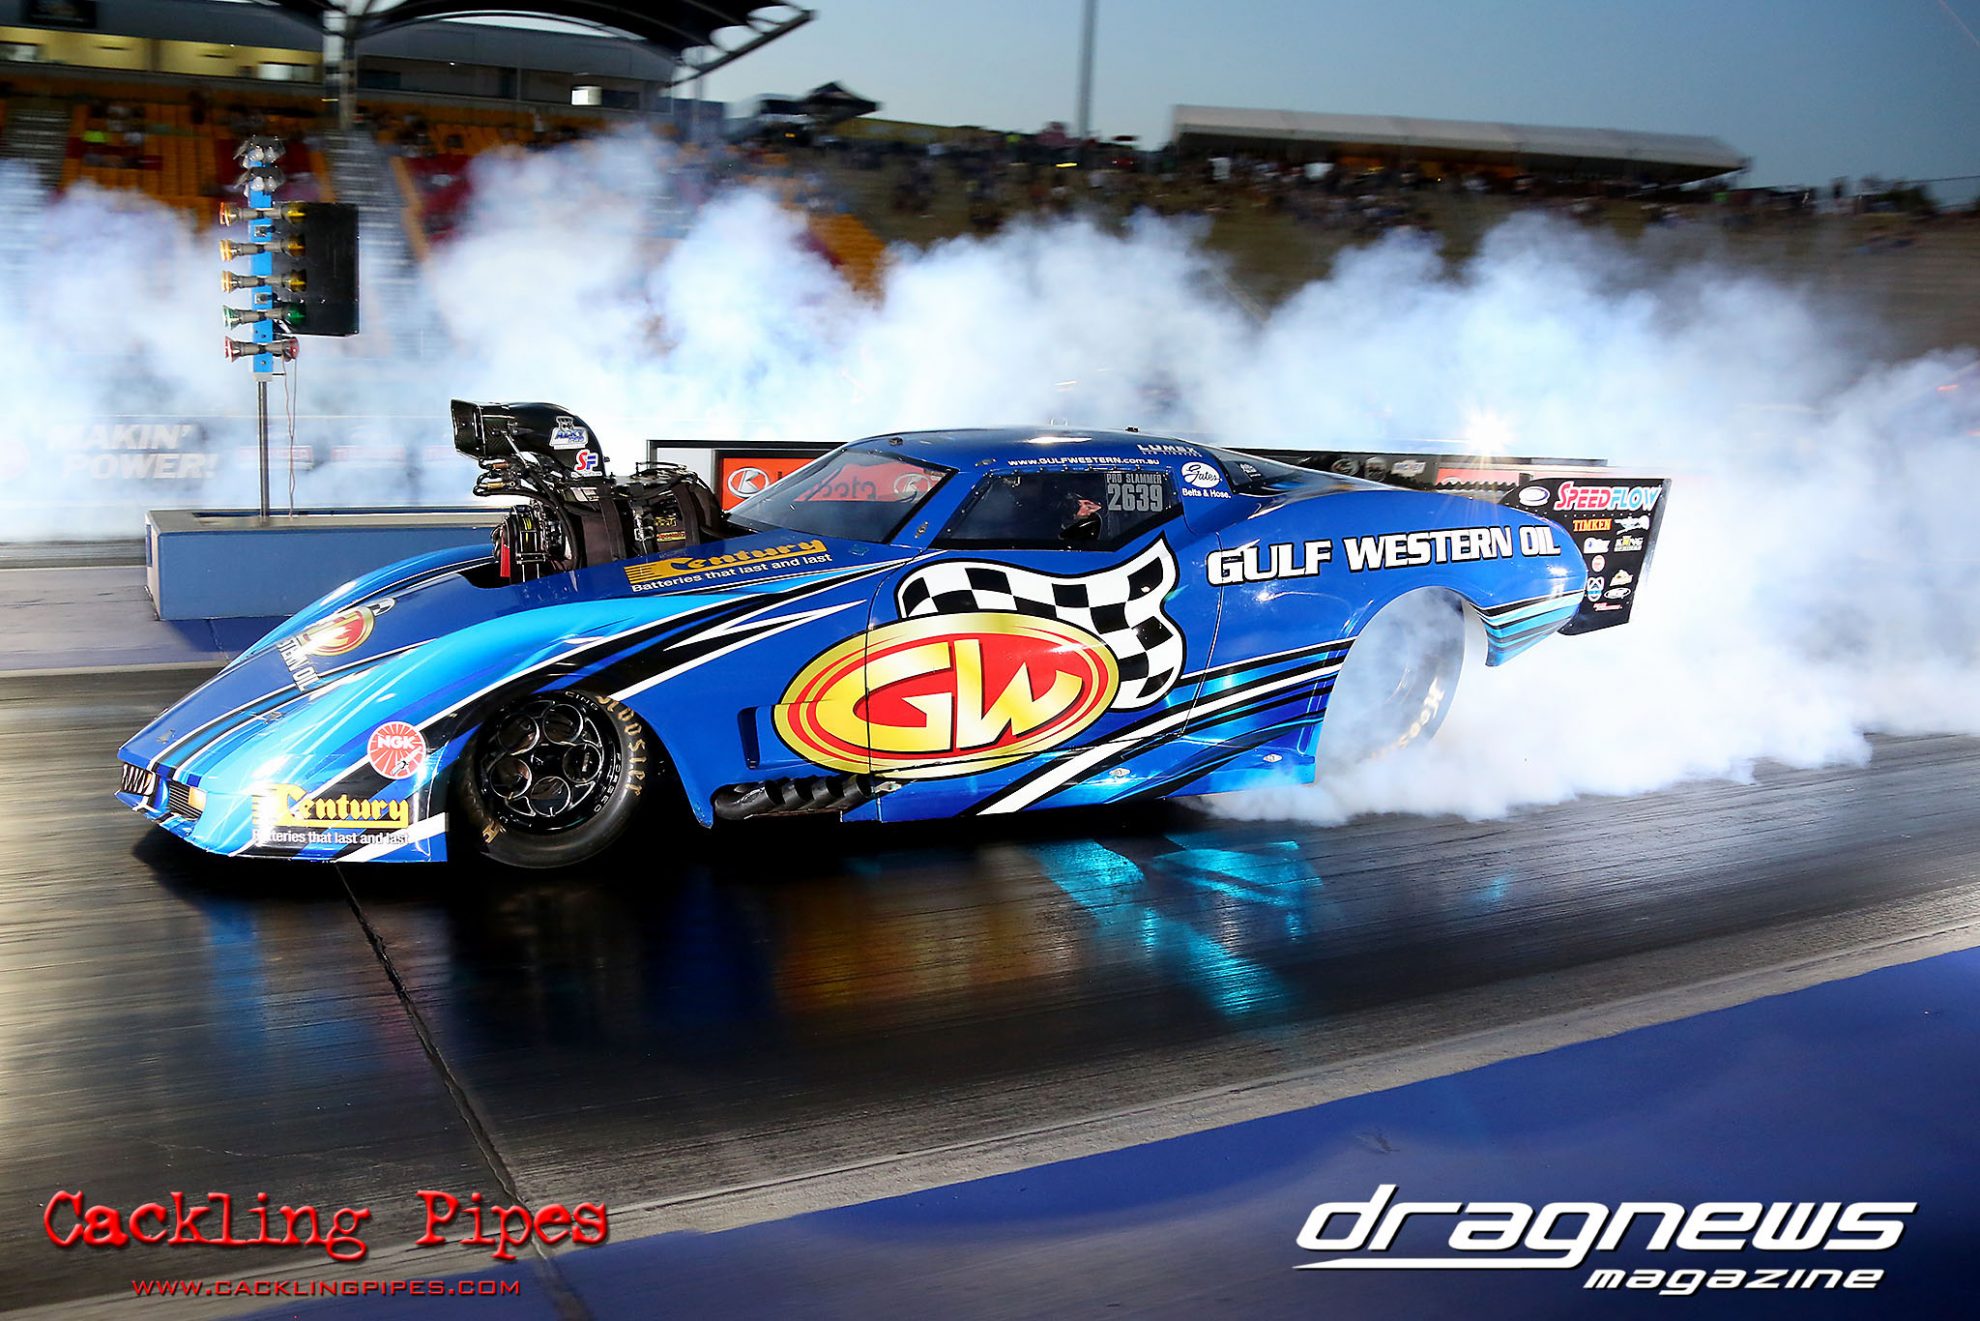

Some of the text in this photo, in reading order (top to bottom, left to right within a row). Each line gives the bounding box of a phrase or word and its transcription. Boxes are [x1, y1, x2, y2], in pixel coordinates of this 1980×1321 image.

[576, 451, 597, 471] SF
[1107, 473, 1162, 484] PRO SLAMMER
[1108, 484, 1163, 512] 2639
[1554, 481, 1662, 511] SPEEDFLOW
[1573, 518, 1612, 532] TIMKEN
[670, 539, 827, 571] Century
[1207, 540, 1332, 586] GULF
[1343, 526, 1511, 571] WESTERN
[1519, 525, 1561, 556] OIL
[631, 553, 832, 592] Batteries that last and last
[814, 638, 1085, 753] GW
[378, 735, 415, 750] NGK
[308, 830, 331, 843] that
[334, 832, 358, 844] last
[359, 833, 382, 844] and
